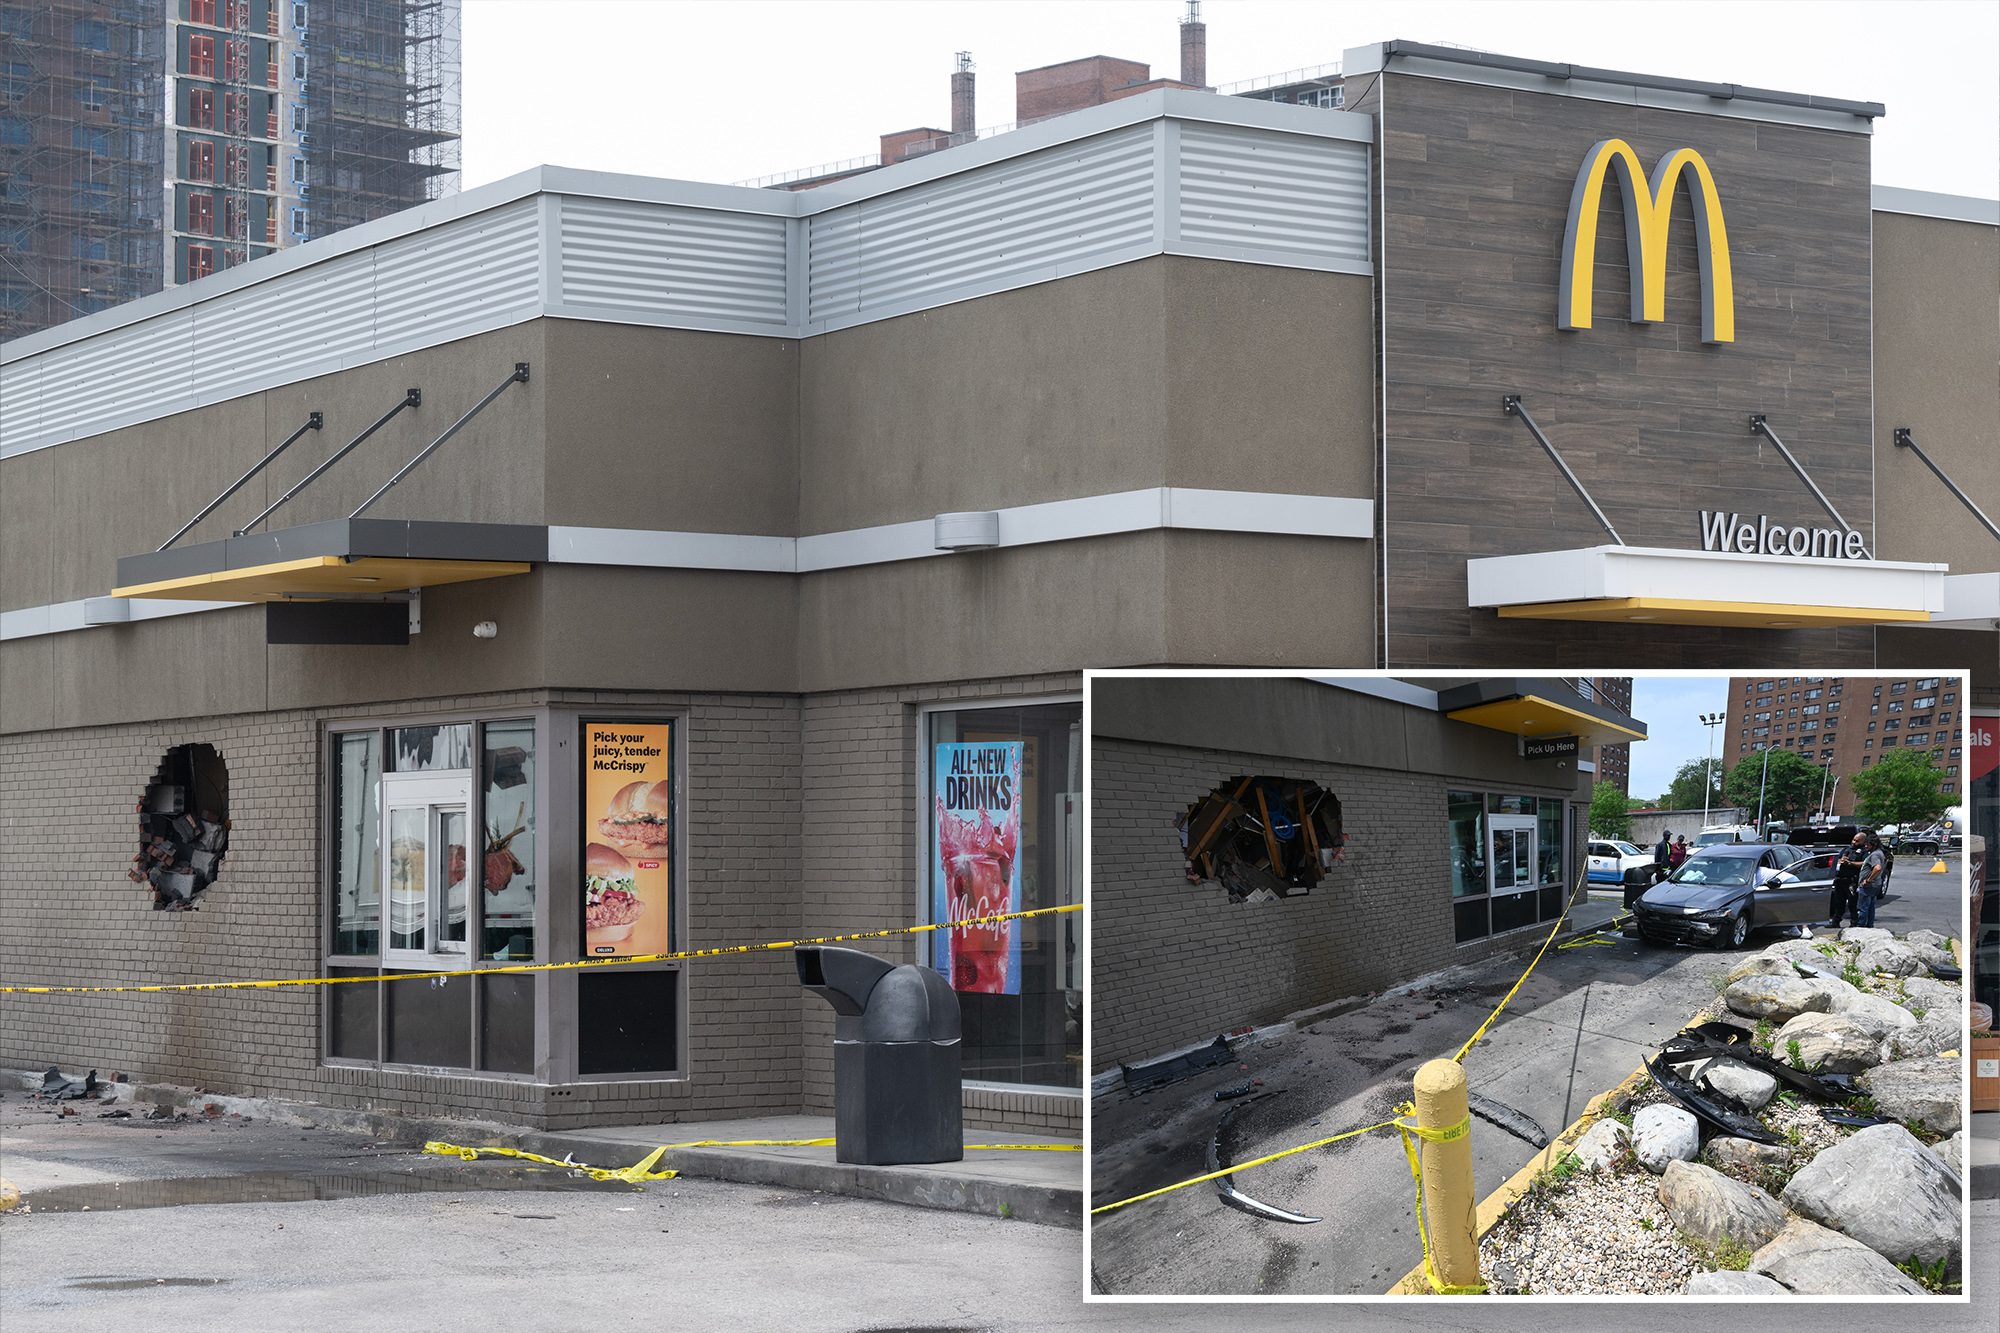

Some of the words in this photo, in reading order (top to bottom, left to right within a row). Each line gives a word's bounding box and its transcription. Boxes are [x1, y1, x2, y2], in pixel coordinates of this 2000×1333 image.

[1698, 510, 1864, 559] Welcome
[594, 731, 618, 742] Pick
[620, 735, 645, 746] your
[593, 745, 623, 759] juicy,
[624, 746, 661, 757] tender
[1528, 746, 1543, 754] Pick
[1545, 744, 1555, 753] Up
[593, 759, 646, 773] McCrispy
[951, 748, 1007, 775] ALL-NEW
[946, 775, 1012, 811] DRINKS
